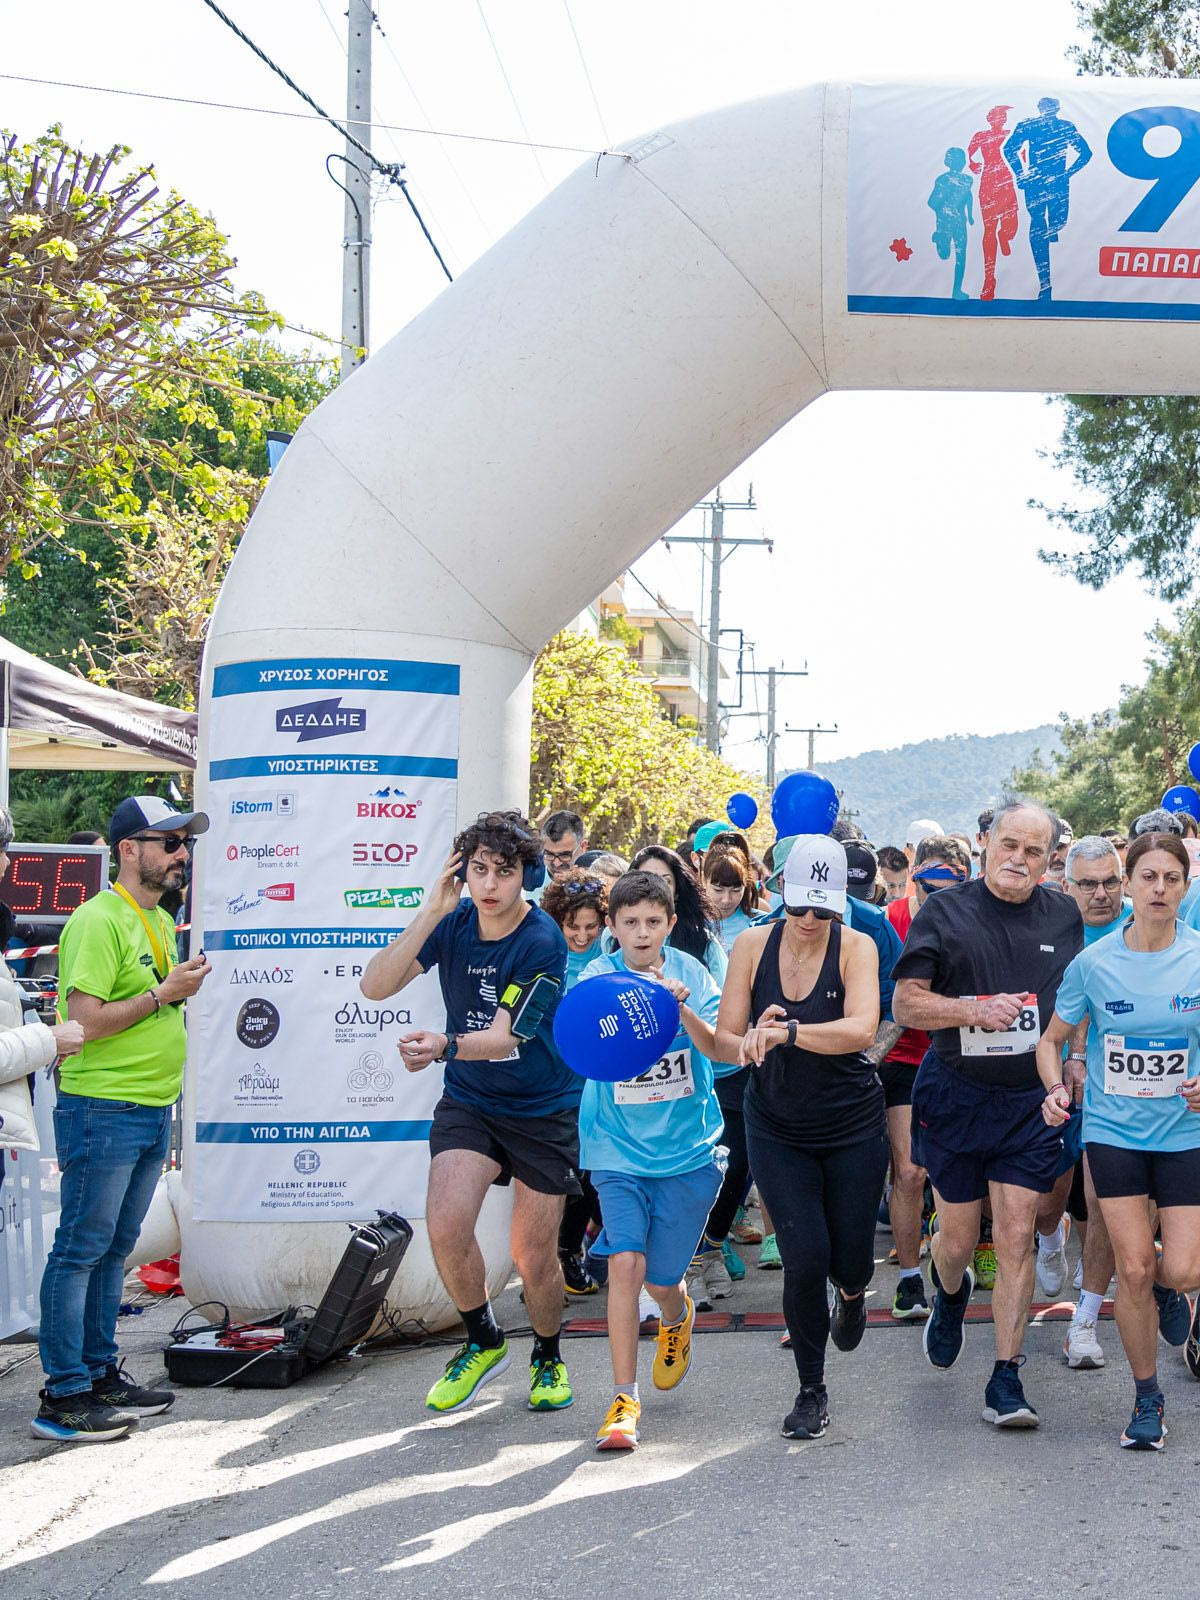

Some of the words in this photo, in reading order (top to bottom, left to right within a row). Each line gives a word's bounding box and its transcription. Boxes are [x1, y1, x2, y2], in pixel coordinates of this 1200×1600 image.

[259, 669, 313, 683] ΧΡΥΣΟΣ
[316, 668, 389, 682] ΧΟΡΗΓΟΣ
[281, 713, 361, 727] ΔΕΔΔΗΕ
[268, 759, 378, 772] ΥΠΟΣΤΗΡΙΚΤΕΣ
[231, 801, 273, 814] iStorm
[356, 803, 417, 819] ΒΙΚΟΣ
[240, 844, 300, 861] PeopleCert
[353, 843, 418, 863] STOP
[12, 857, 86, 911] 56
[233, 933, 286, 946] ΤΟΠΙΚΟΙ
[291, 931, 402, 945] ΥΠΟΣΤΗΡΙΚΤΕ
[245, 1016, 269, 1025] Juicy
[335, 1002, 412, 1031] όλυρα
[617, 993, 643, 1040] ΛΕΥΚΟΣ
[626, 990, 652, 1038] ΣΤΑΥΡΟΣ
[622, 1054, 686, 1083] 231
[1108, 1052, 1185, 1076] 5032
[251, 1127, 280, 1139] ΥΠΟ
[283, 1127, 314, 1138] ΤΗΝ
[319, 1126, 370, 1138] ΑΙΓΙΔΑ
[267, 1181, 304, 1189] HELLENIC
[270, 1191, 297, 1199] Ministry
[306, 1191, 344, 1199] Education,
[261, 1201, 290, 1209] Religious
[331, 1200, 354, 1208] Sports
